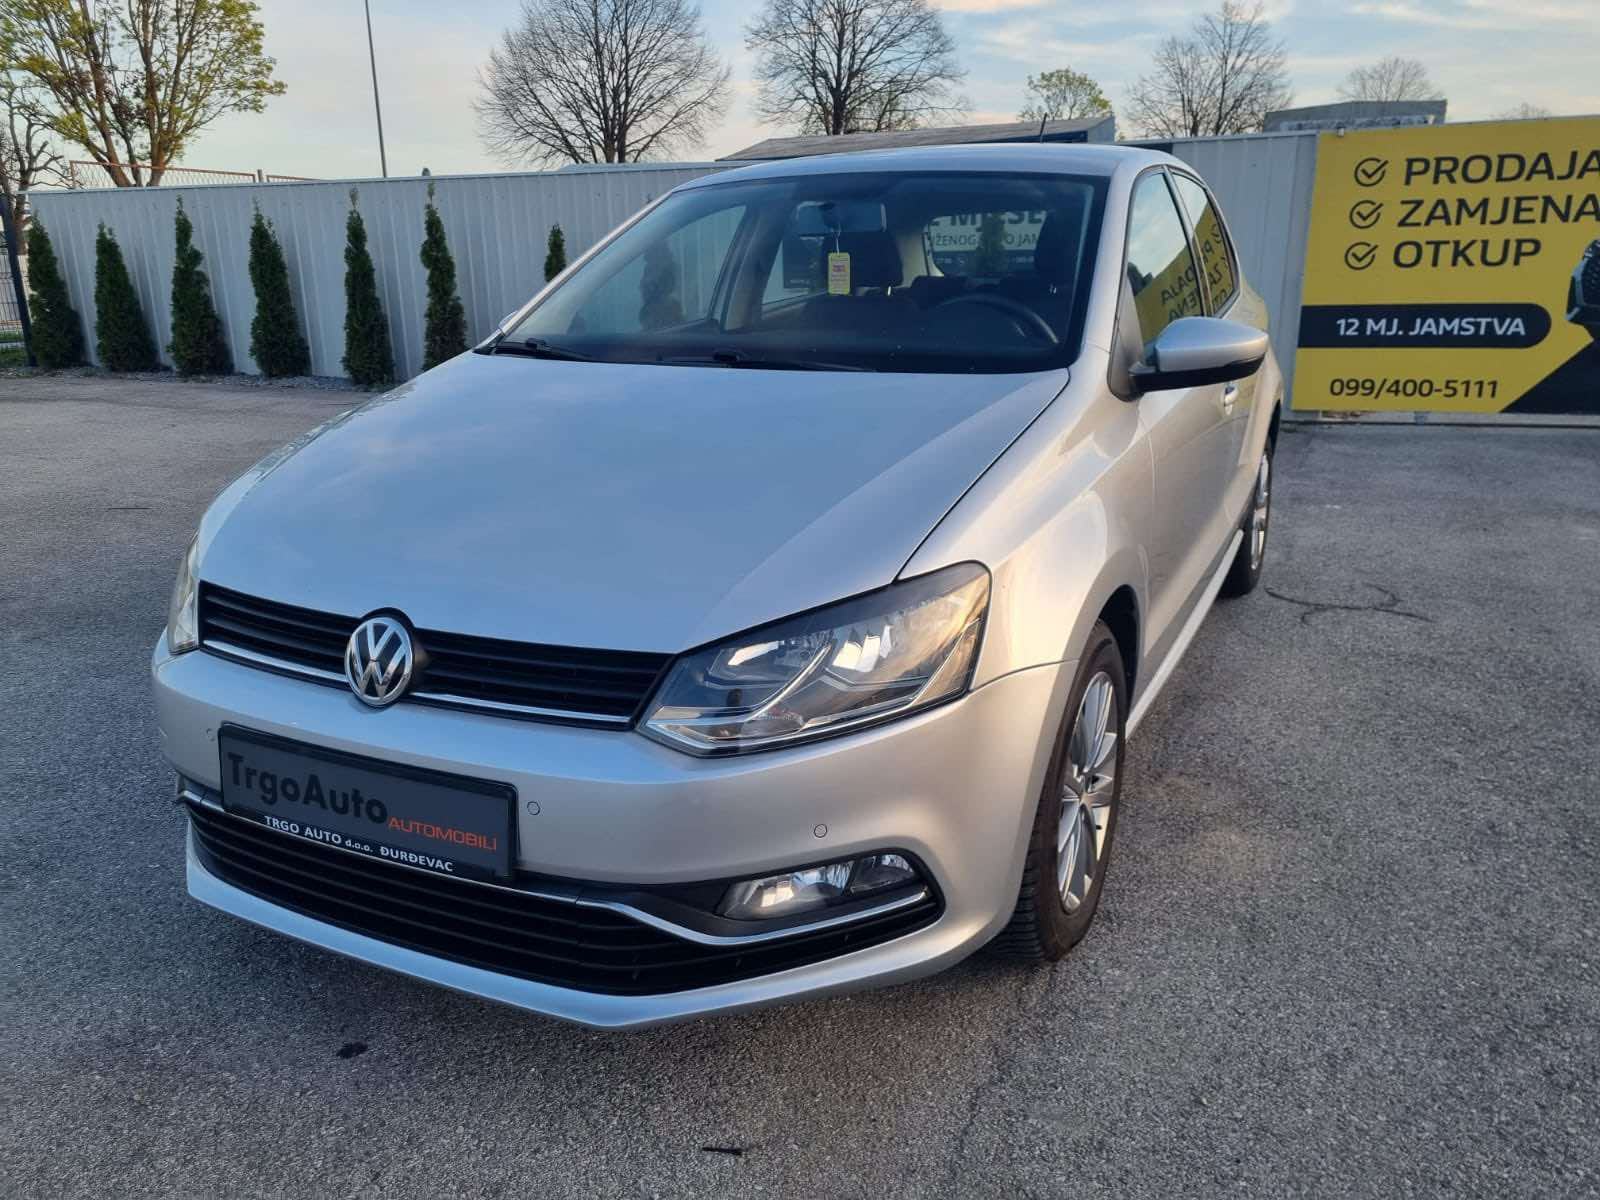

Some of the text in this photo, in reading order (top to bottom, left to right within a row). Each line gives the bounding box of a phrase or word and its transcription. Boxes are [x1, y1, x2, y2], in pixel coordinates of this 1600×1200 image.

[1404, 151, 1600, 186] PRODAJA
[1397, 193, 1600, 228] ZAMJENA
[1393, 238, 1542, 268] OTKUP
[1336, 317, 1526, 336] 12 MJ. JAMSTVA
[1330, 378, 1498, 399] 099/400-5111
[227, 752, 497, 851] TrgoAuto AUTOMOBILI
[264, 815, 454, 872] TRGO AUTO d.o.o. ĐURĐEVAC
